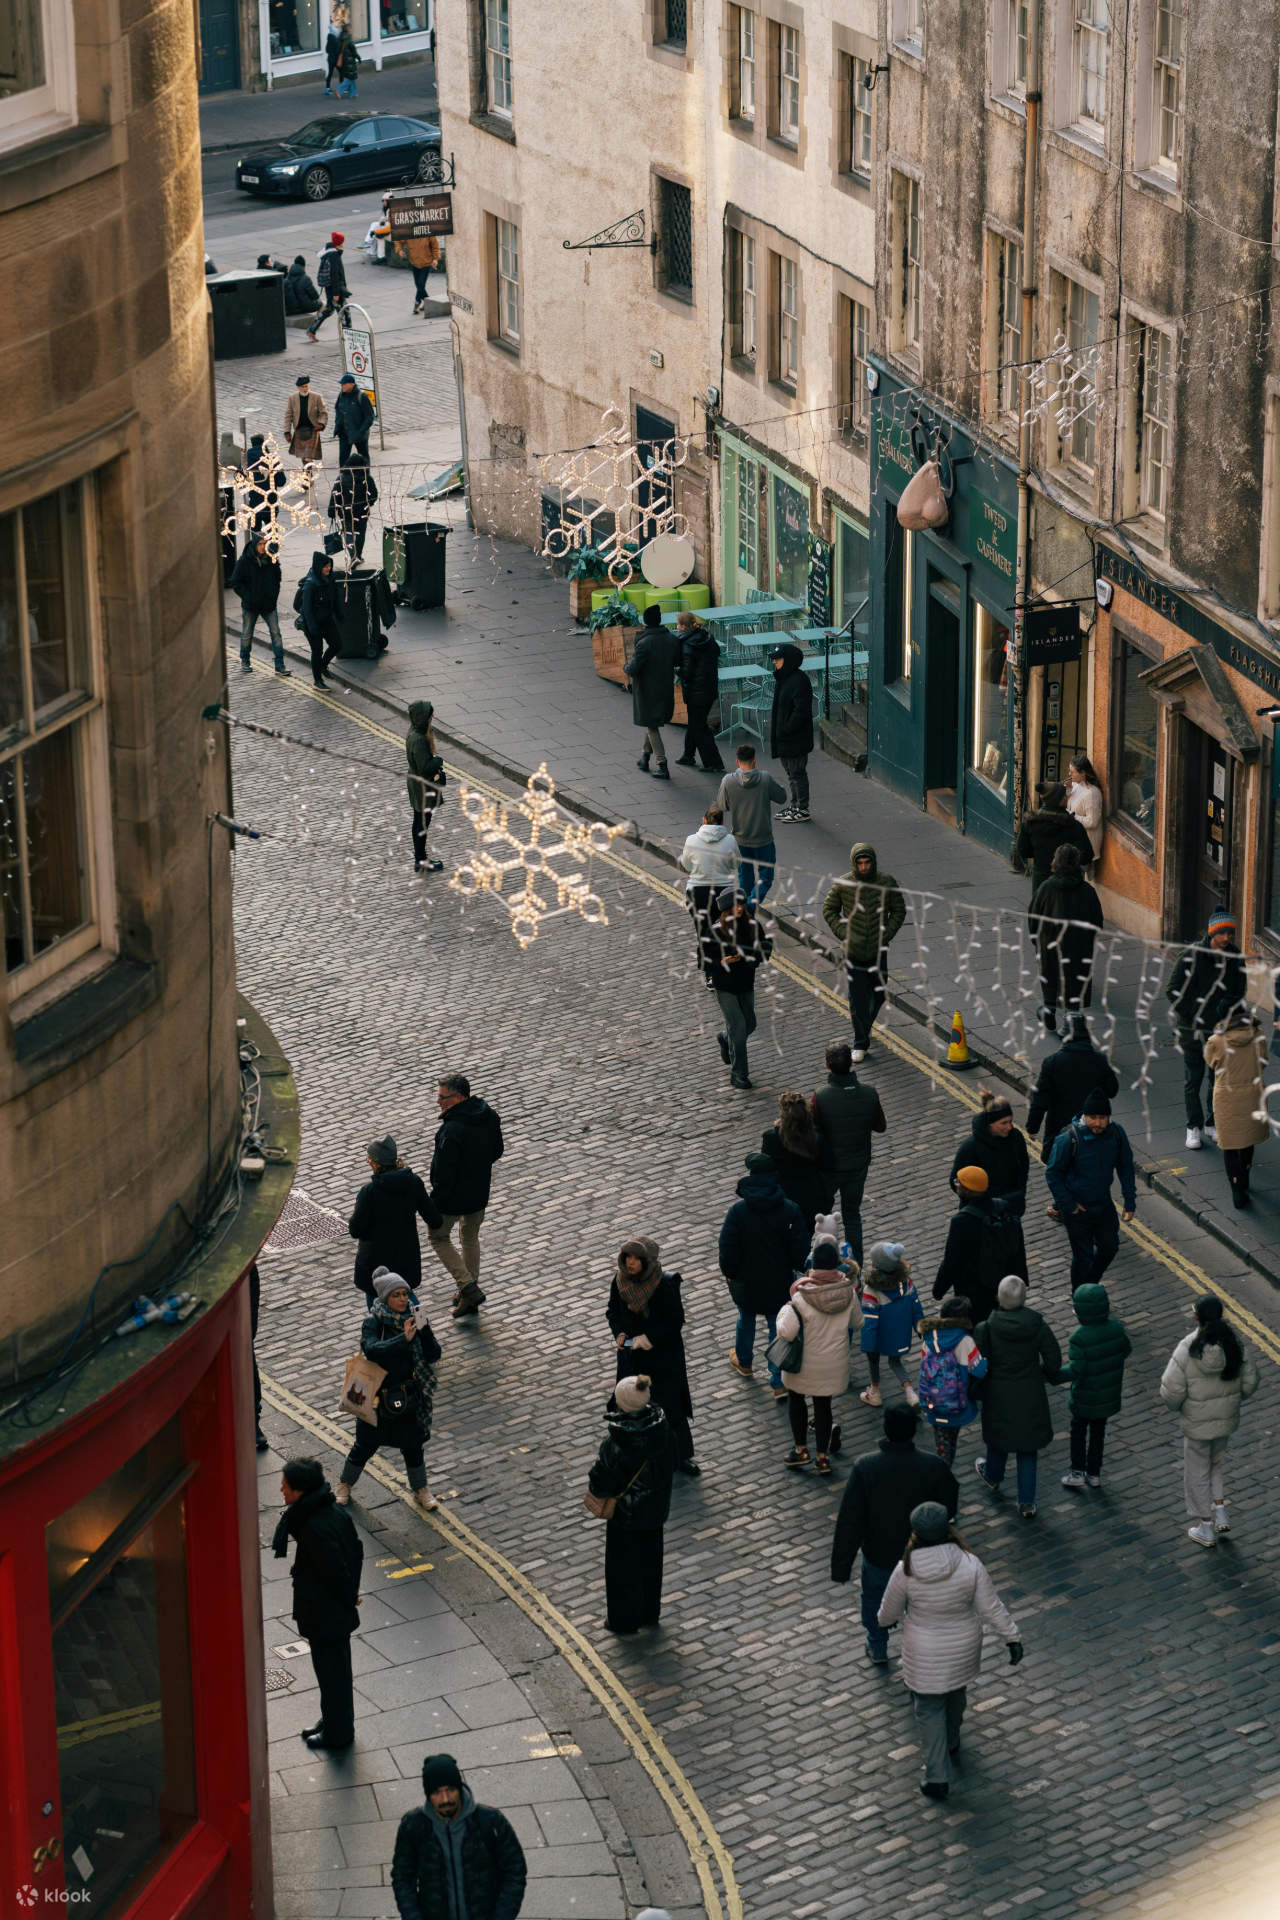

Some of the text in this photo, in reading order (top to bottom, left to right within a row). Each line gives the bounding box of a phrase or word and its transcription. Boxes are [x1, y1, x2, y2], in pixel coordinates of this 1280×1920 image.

[414, 197, 425, 207] THE
[394, 207, 449, 225] GRASSMARKET
[413, 225, 431, 235] HOTEL
[983, 502, 1007, 533] TWEED
[991, 529, 998, 546] &
[976, 537, 1012, 577] CASHMERE
[1101, 552, 1176, 621] ISLANDER
[1031, 635, 1075, 646] ISLANDER
[1230, 645, 1280, 694] FLAGSHI
